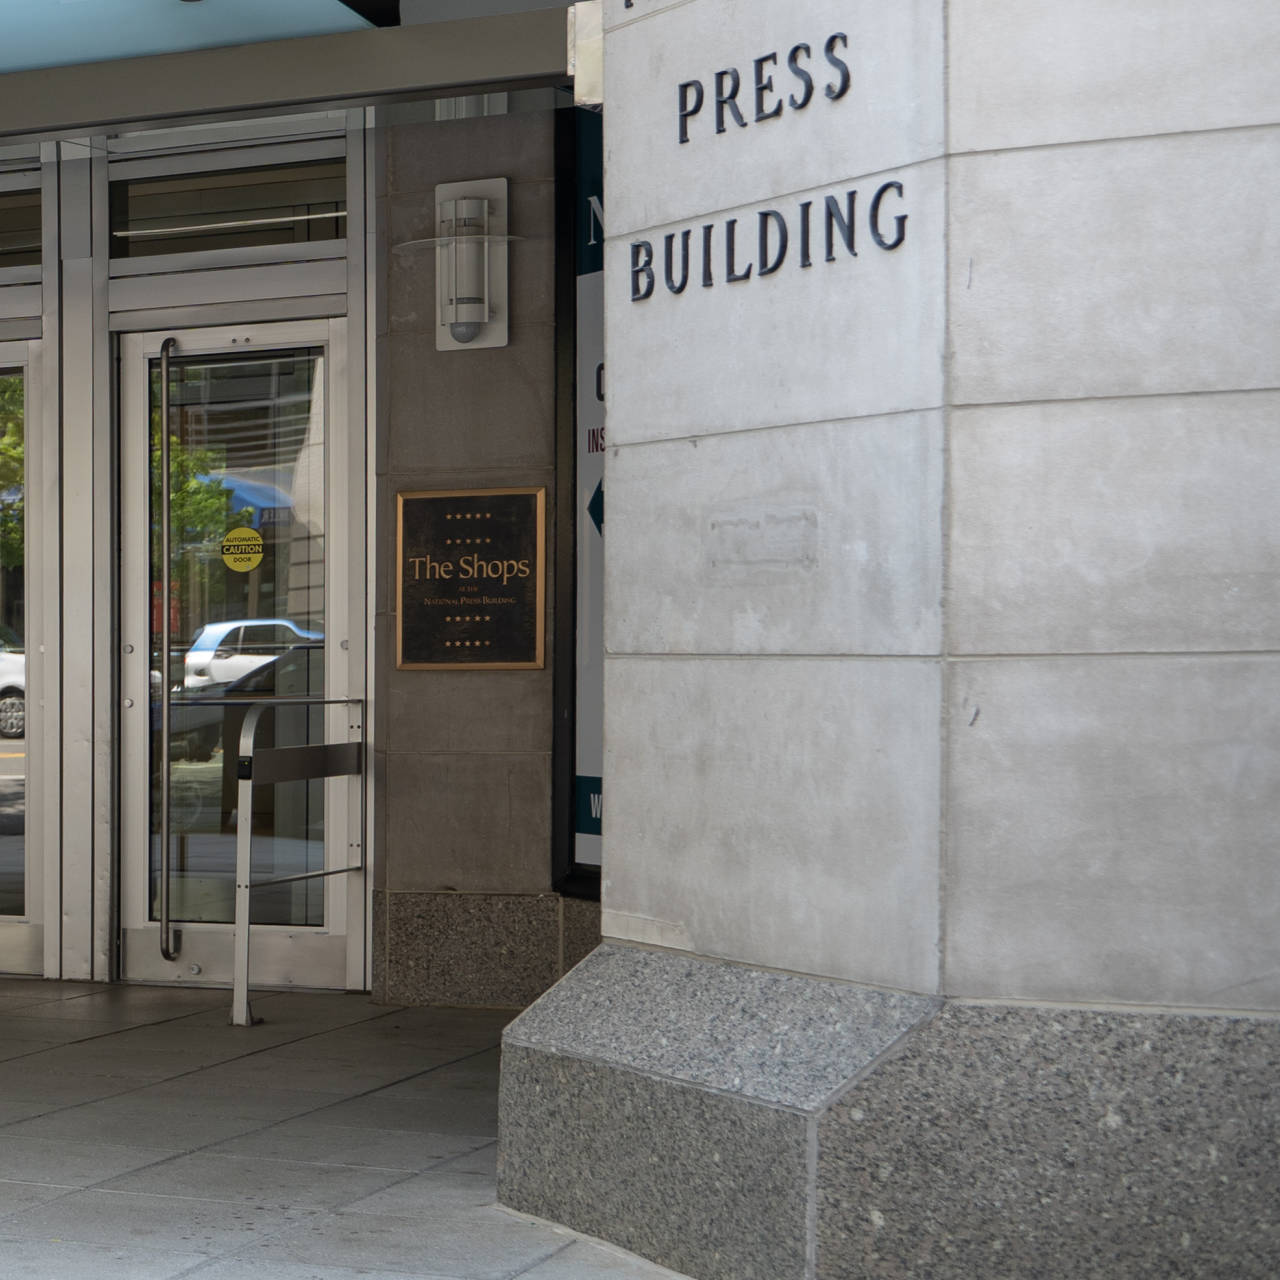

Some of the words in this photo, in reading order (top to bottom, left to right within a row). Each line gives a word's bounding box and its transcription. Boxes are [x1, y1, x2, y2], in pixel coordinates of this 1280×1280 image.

[678, 32, 851, 144] PRESS
[630, 181, 909, 302] BUILDING
[223, 545, 262, 553] CAUTION
[409, 554, 453, 580] The
[459, 553, 530, 585] Shops
